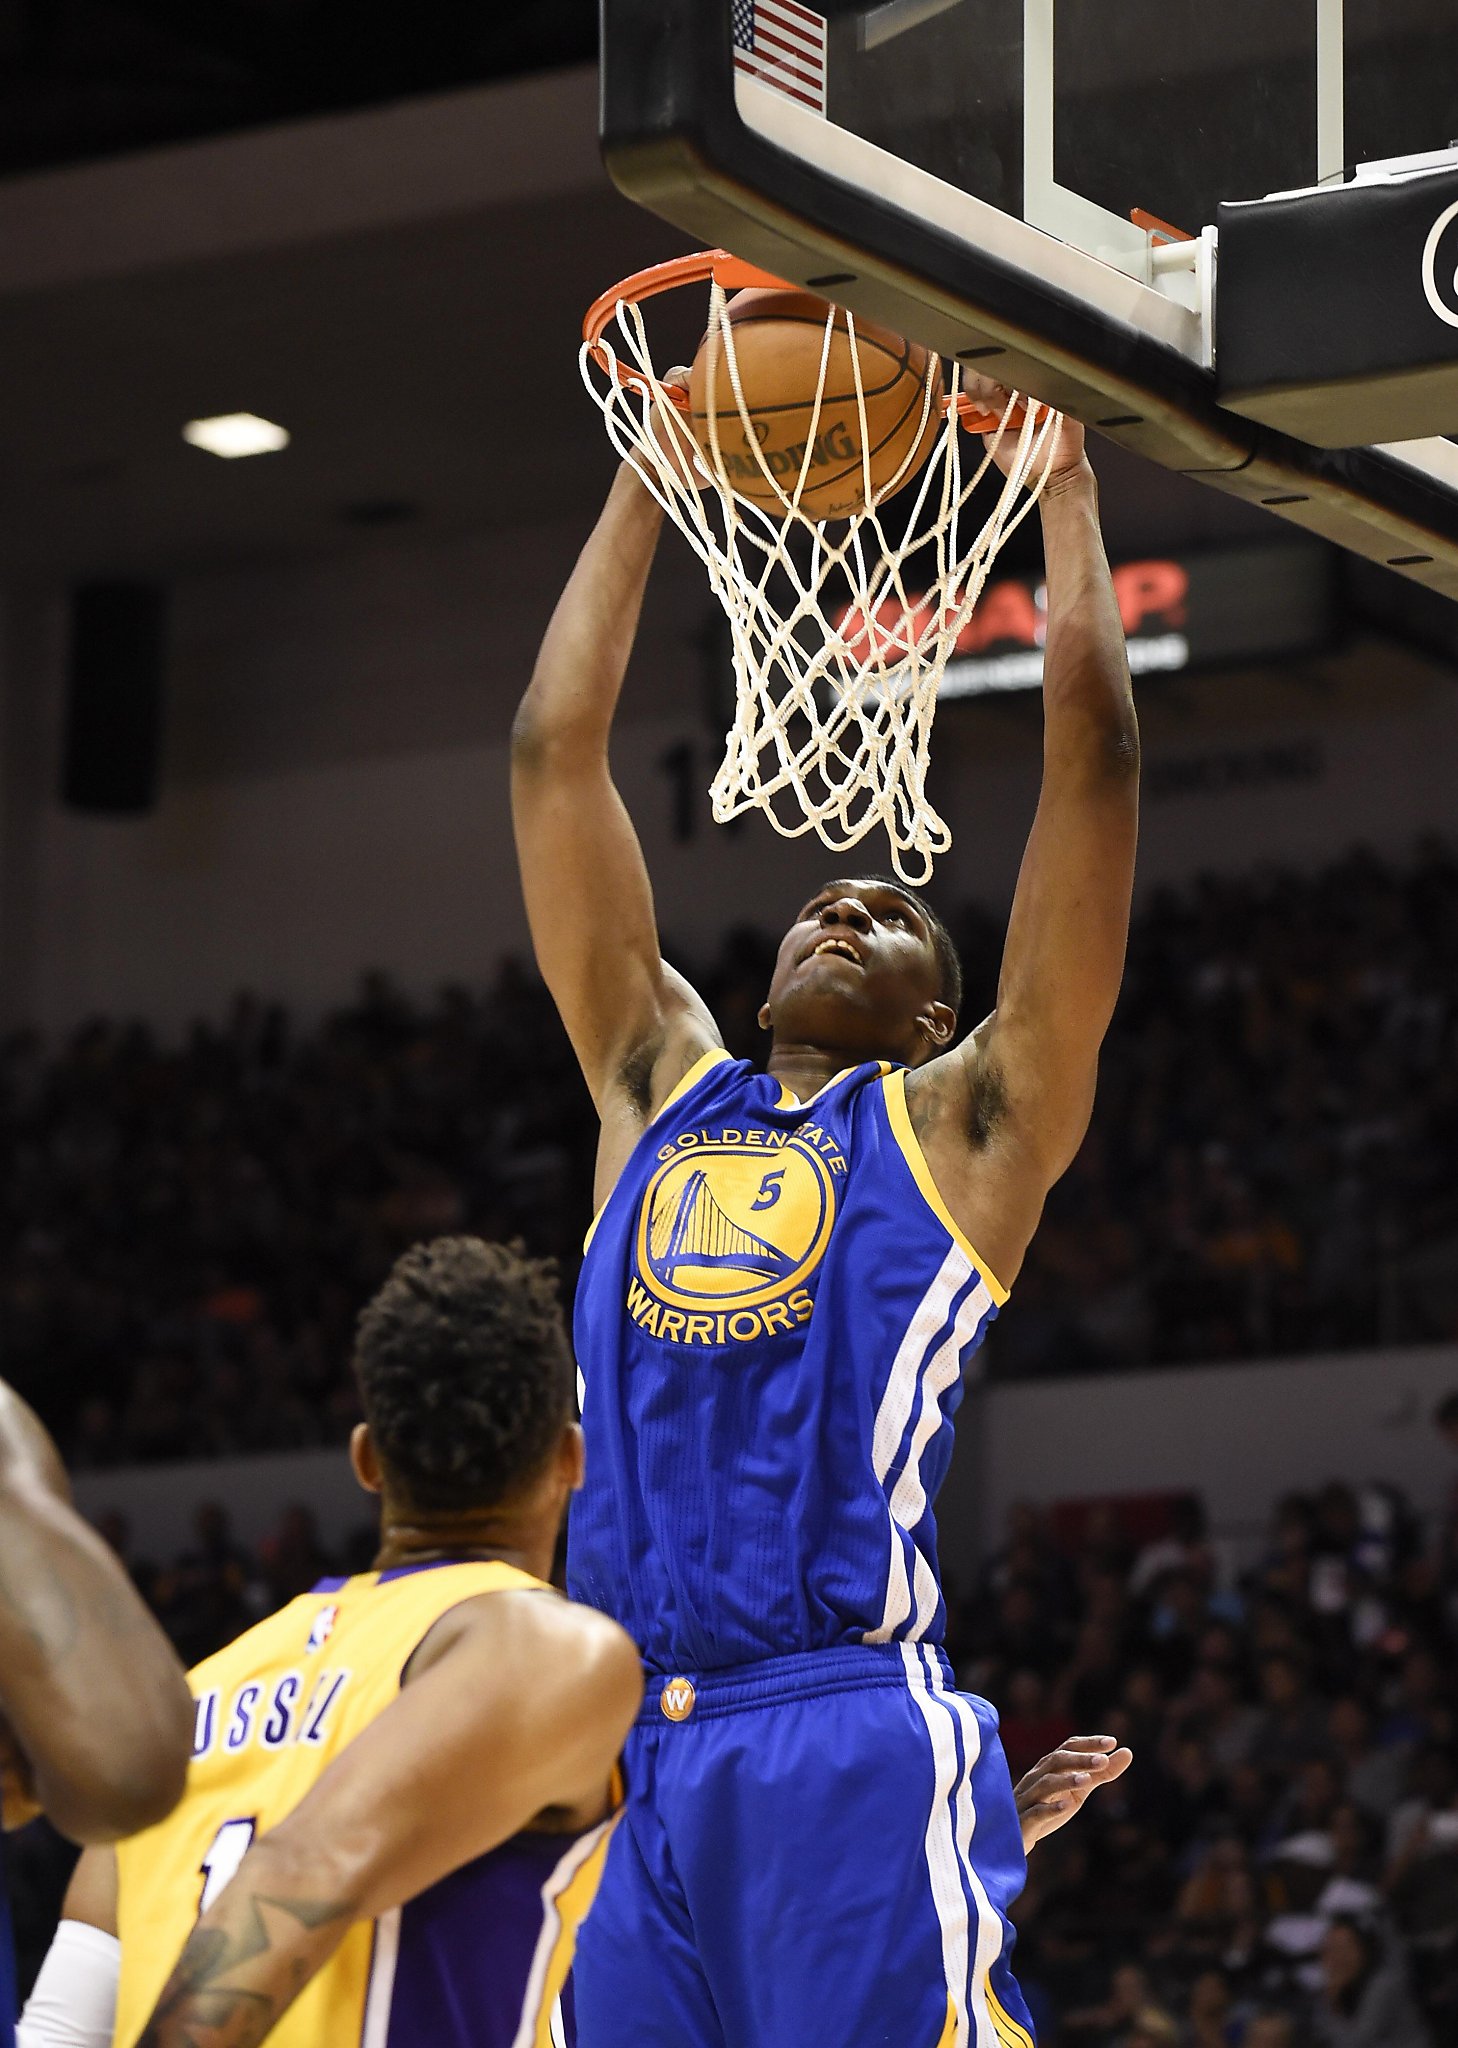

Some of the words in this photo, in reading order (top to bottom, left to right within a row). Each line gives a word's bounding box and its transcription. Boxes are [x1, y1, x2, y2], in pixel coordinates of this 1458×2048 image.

[657, 1130, 787, 1162] GOLDEN
[750, 1167, 787, 1211] 5
[626, 1276, 814, 1345] WARRIORS
[664, 1689, 690, 1711] W
